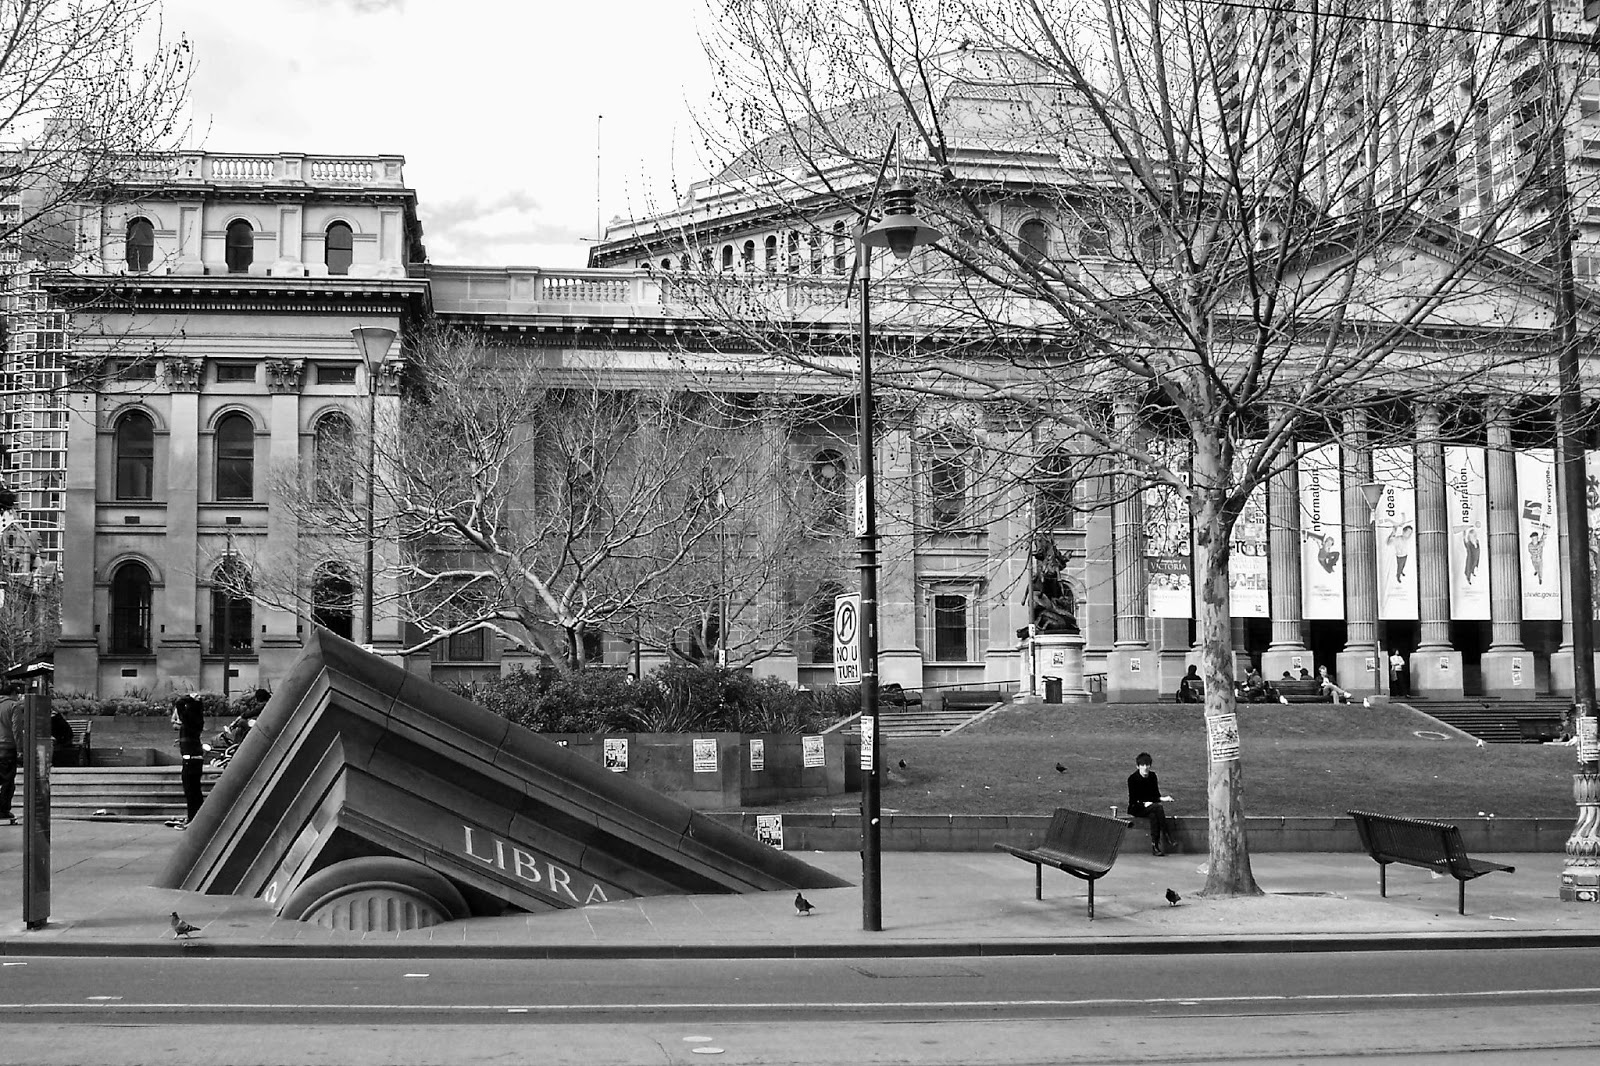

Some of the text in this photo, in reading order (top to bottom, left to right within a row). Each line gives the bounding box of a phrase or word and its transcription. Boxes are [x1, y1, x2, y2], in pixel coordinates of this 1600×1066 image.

[1150, 561, 1187, 570] VICTORIA
[836, 645, 858, 662] NO U
[837, 664, 858, 679] TURN
[463, 825, 608, 904] LIBRA
